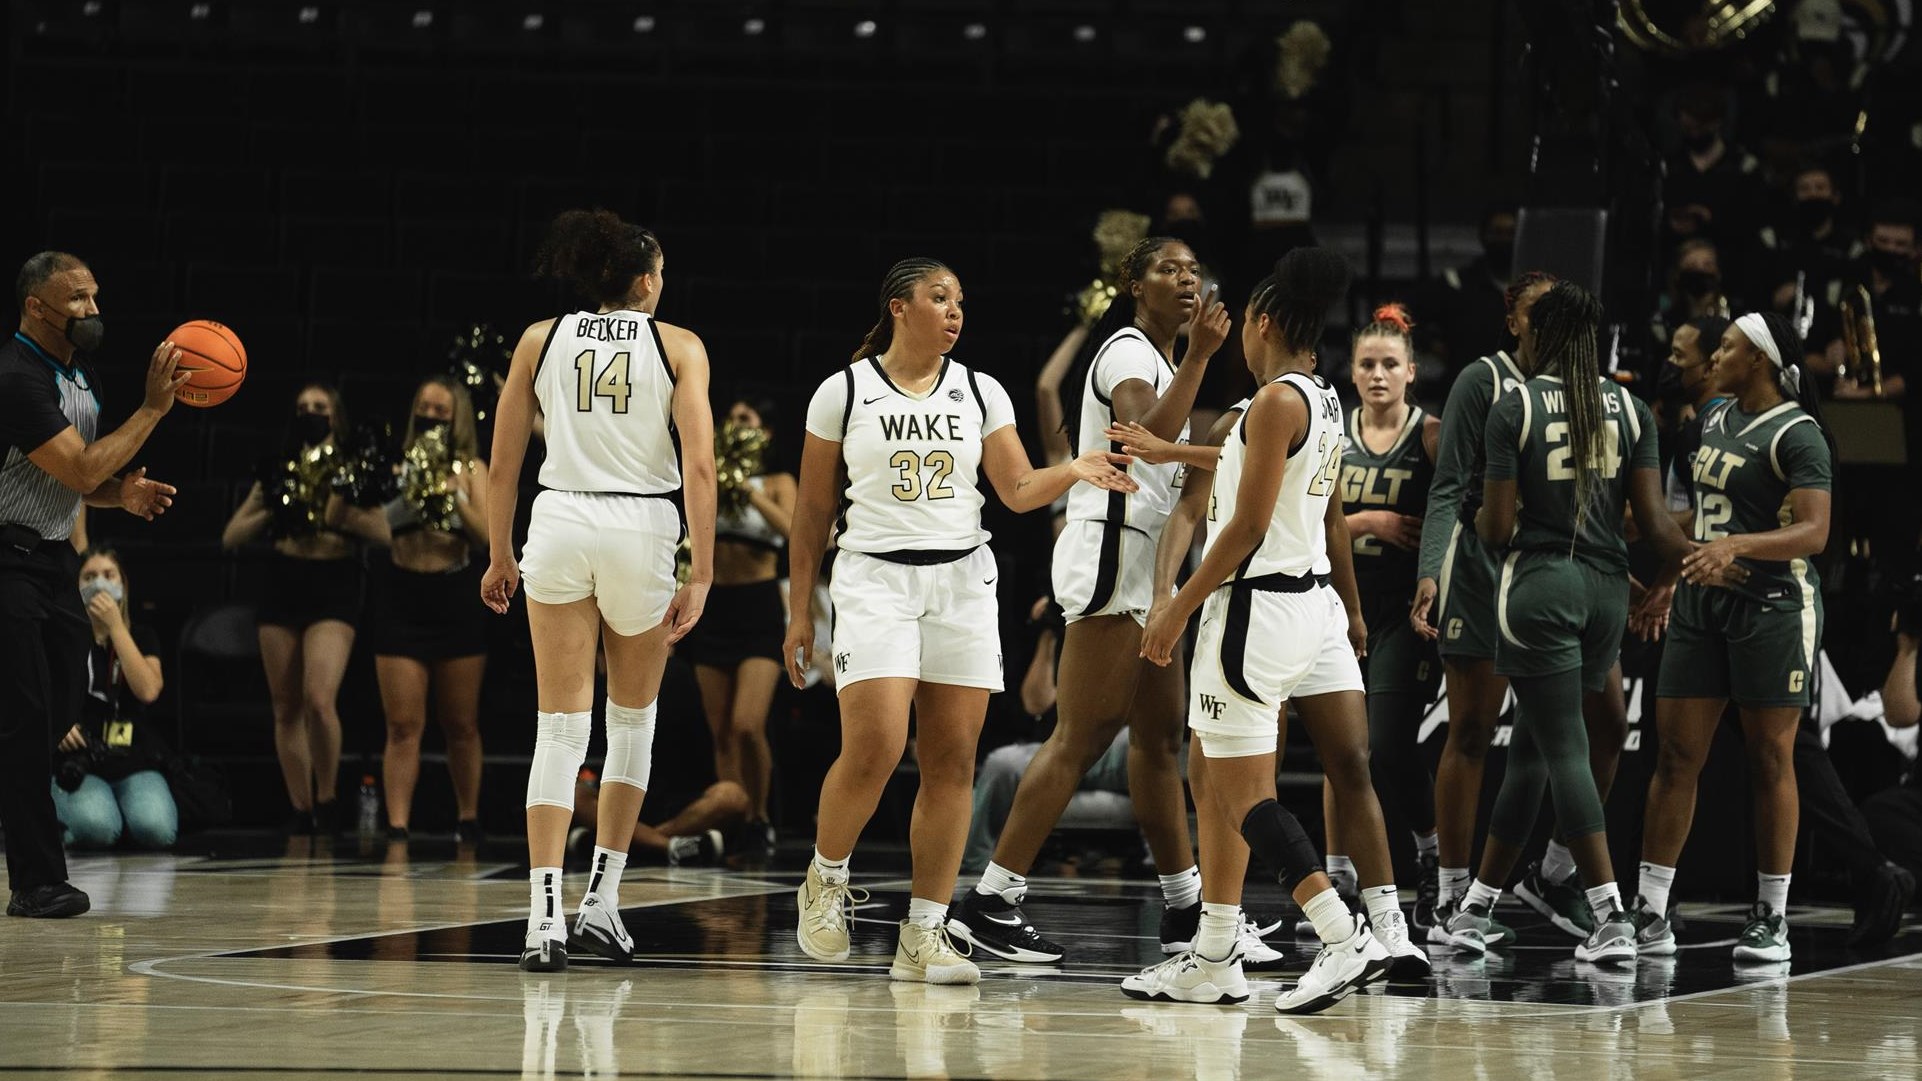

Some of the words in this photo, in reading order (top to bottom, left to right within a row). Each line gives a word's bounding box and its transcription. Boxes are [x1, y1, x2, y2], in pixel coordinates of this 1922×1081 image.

[576, 317, 638, 342] BECKER
[574, 349, 632, 414] 14
[879, 414, 964, 441] WAKE
[889, 450, 955, 502] 32
[1340, 464, 1413, 506] CLT
[1199, 693, 1227, 721] WF
